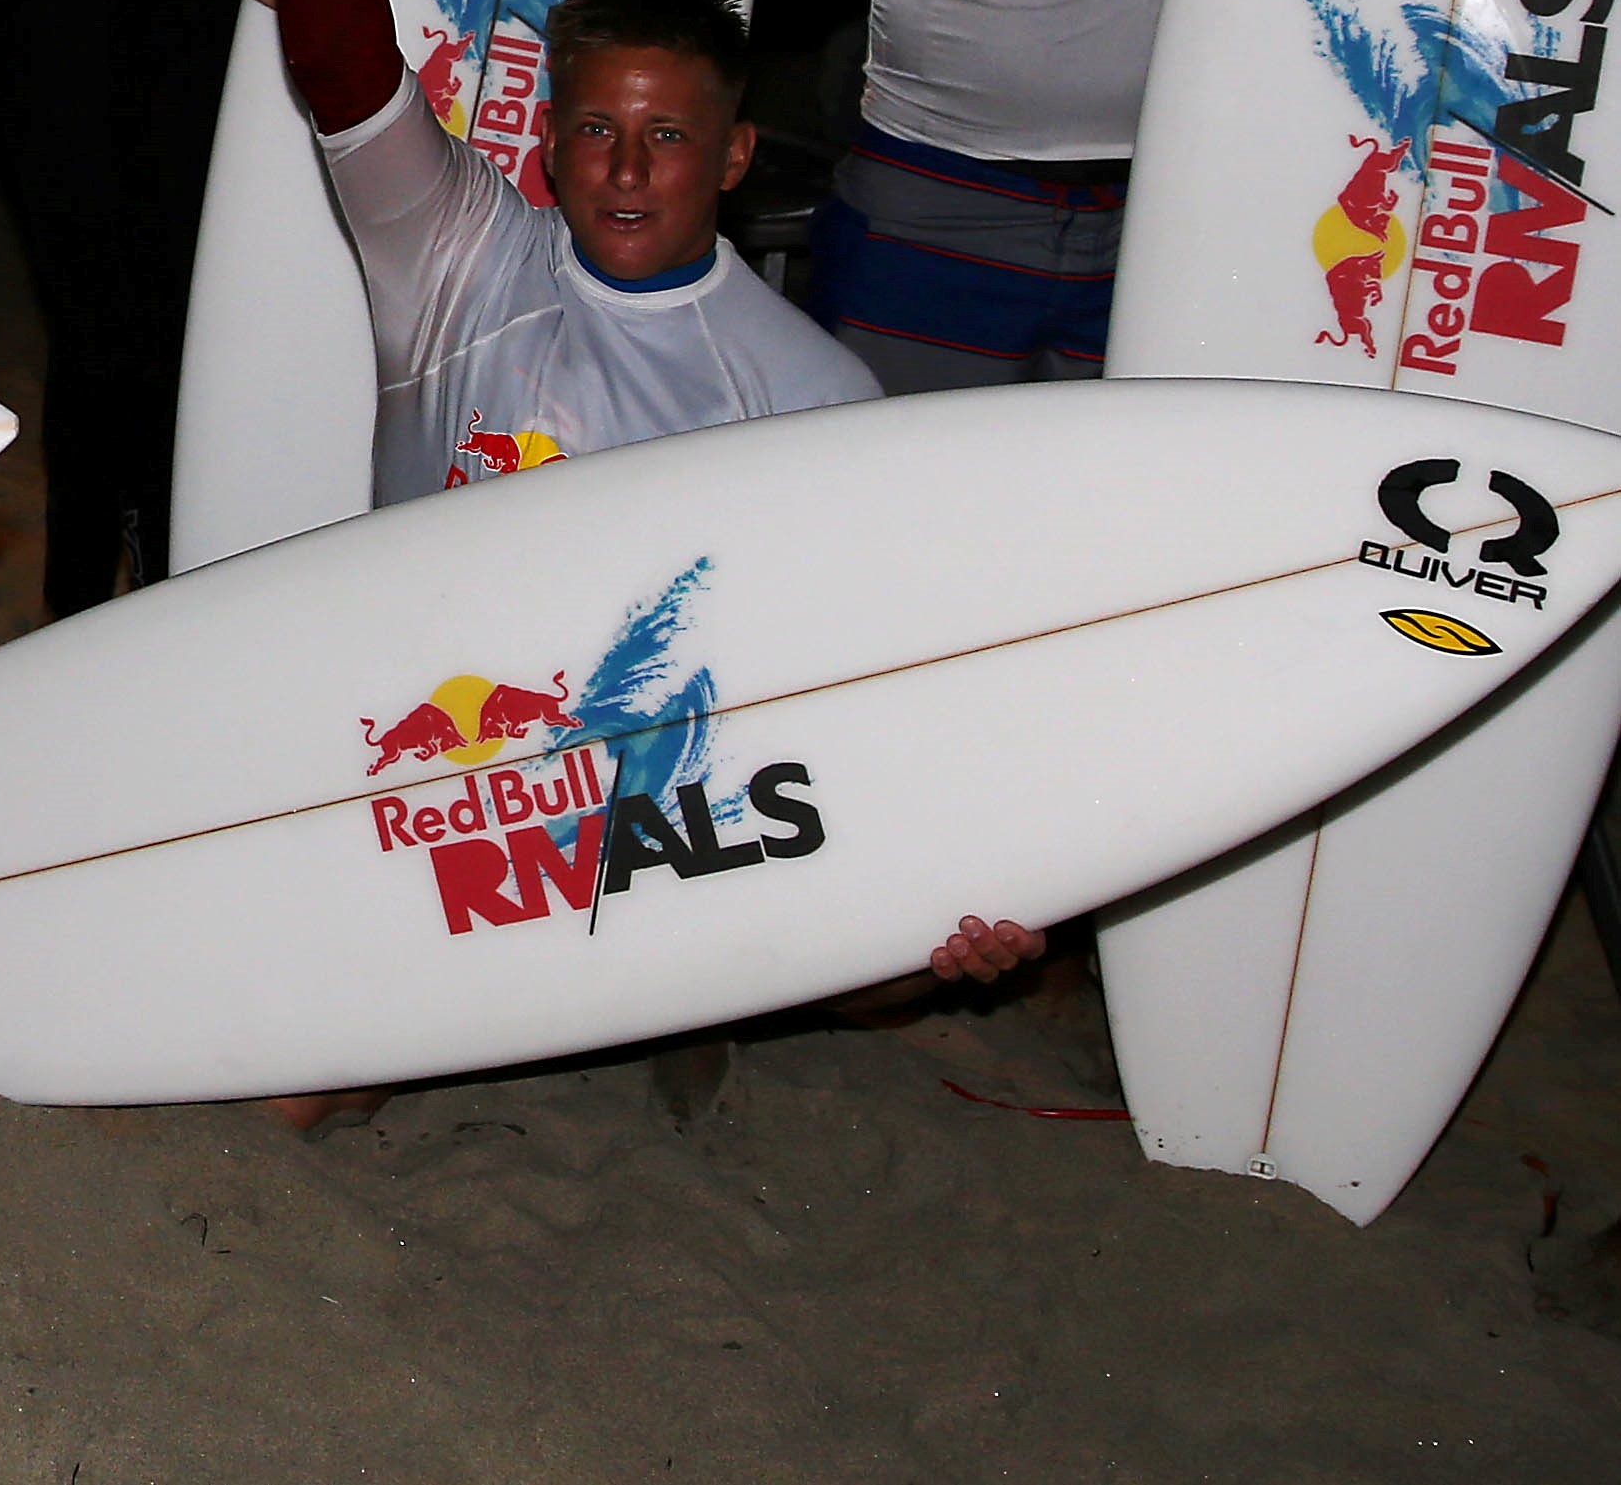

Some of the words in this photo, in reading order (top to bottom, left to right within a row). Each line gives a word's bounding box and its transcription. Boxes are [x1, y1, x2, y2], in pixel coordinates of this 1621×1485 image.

[476, 33, 545, 137] Bull
[1420, 140, 1495, 254] Bull
[1398, 257, 1475, 376] Red
[1357, 539, 1549, 612] QUIVER
[370, 774, 489, 852] Red
[488, 748, 608, 827] Bull
[428, 760, 827, 937] RIVALS
